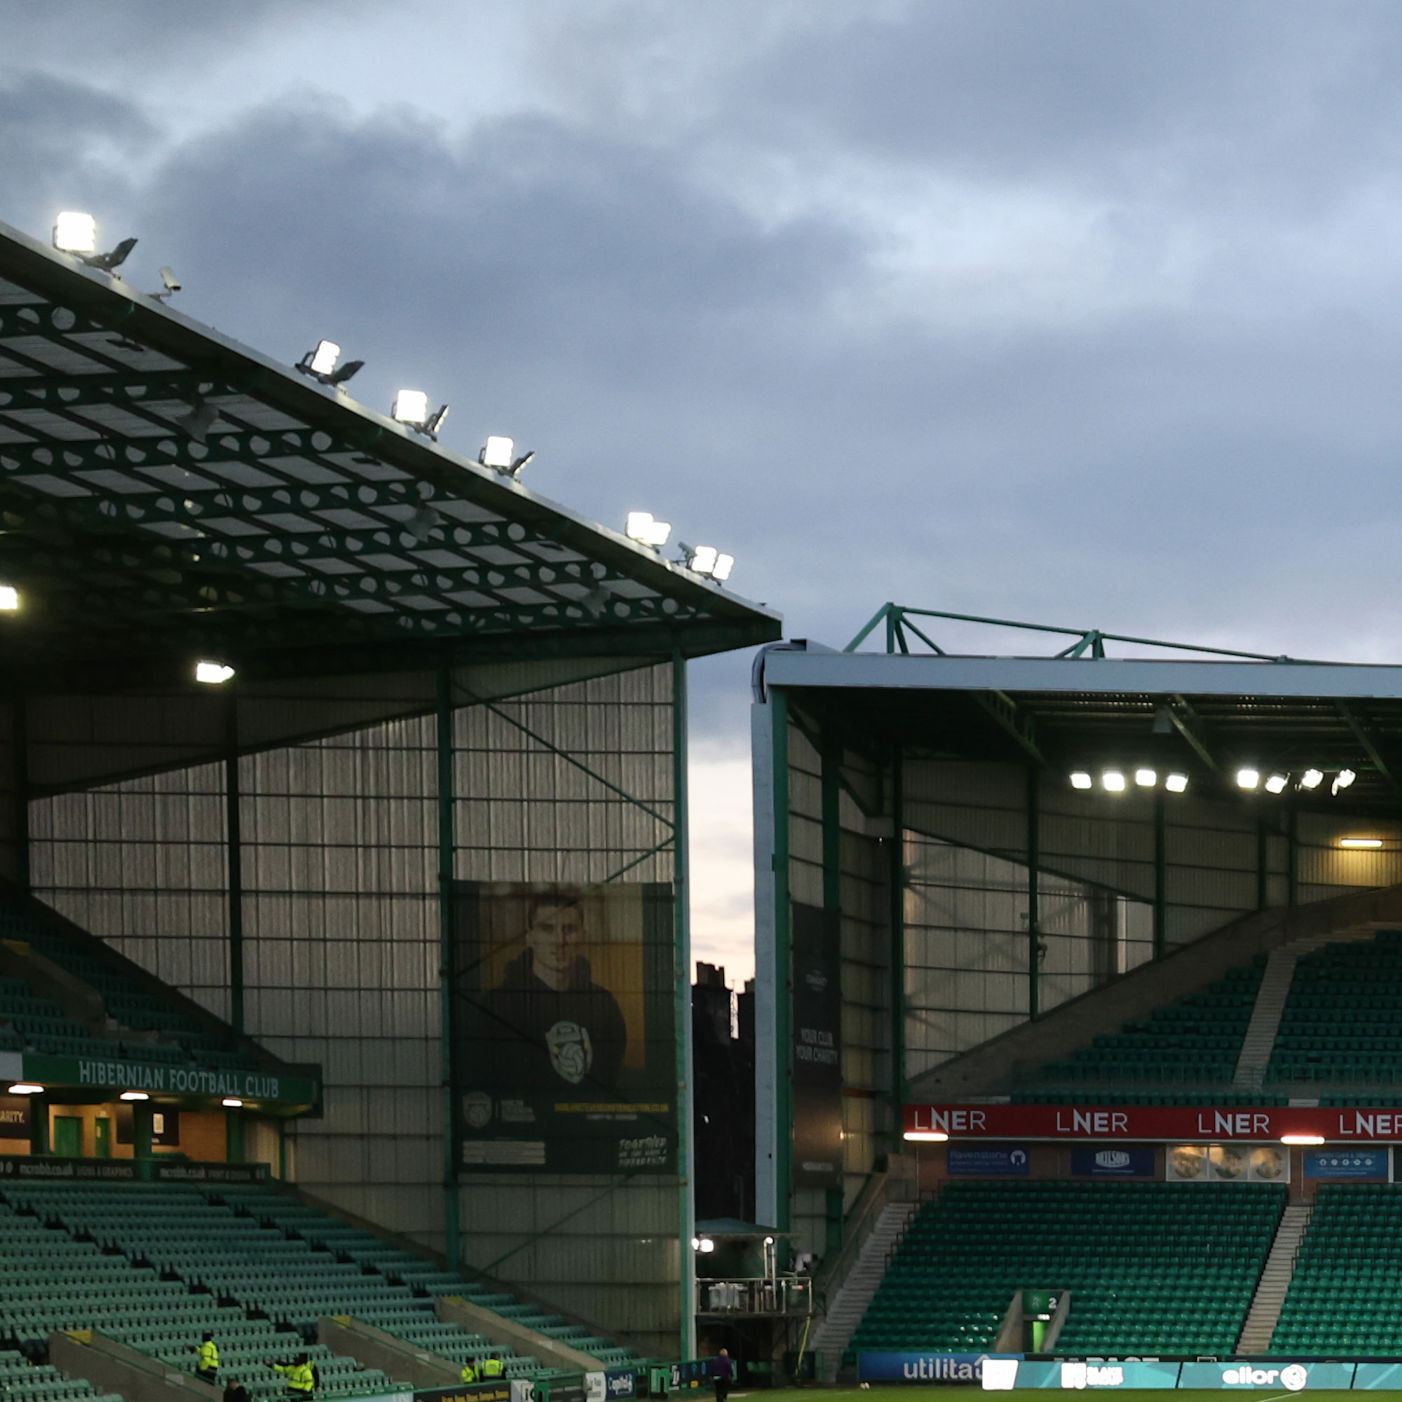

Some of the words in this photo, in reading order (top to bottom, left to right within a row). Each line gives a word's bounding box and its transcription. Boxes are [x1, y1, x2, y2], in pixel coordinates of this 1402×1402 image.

[79, 1060, 163, 1089] HIBERNIAN
[170, 1069, 242, 1096] FOOTBALL
[246, 1076, 280, 1099] CLUB
[914, 1107, 987, 1134] LNER
[1056, 1108, 1129, 1135] LNER
[1198, 1111, 1270, 1136] LNER
[1048, 1297, 1057, 1309] 2
[904, 1357, 973, 1380] utilita
